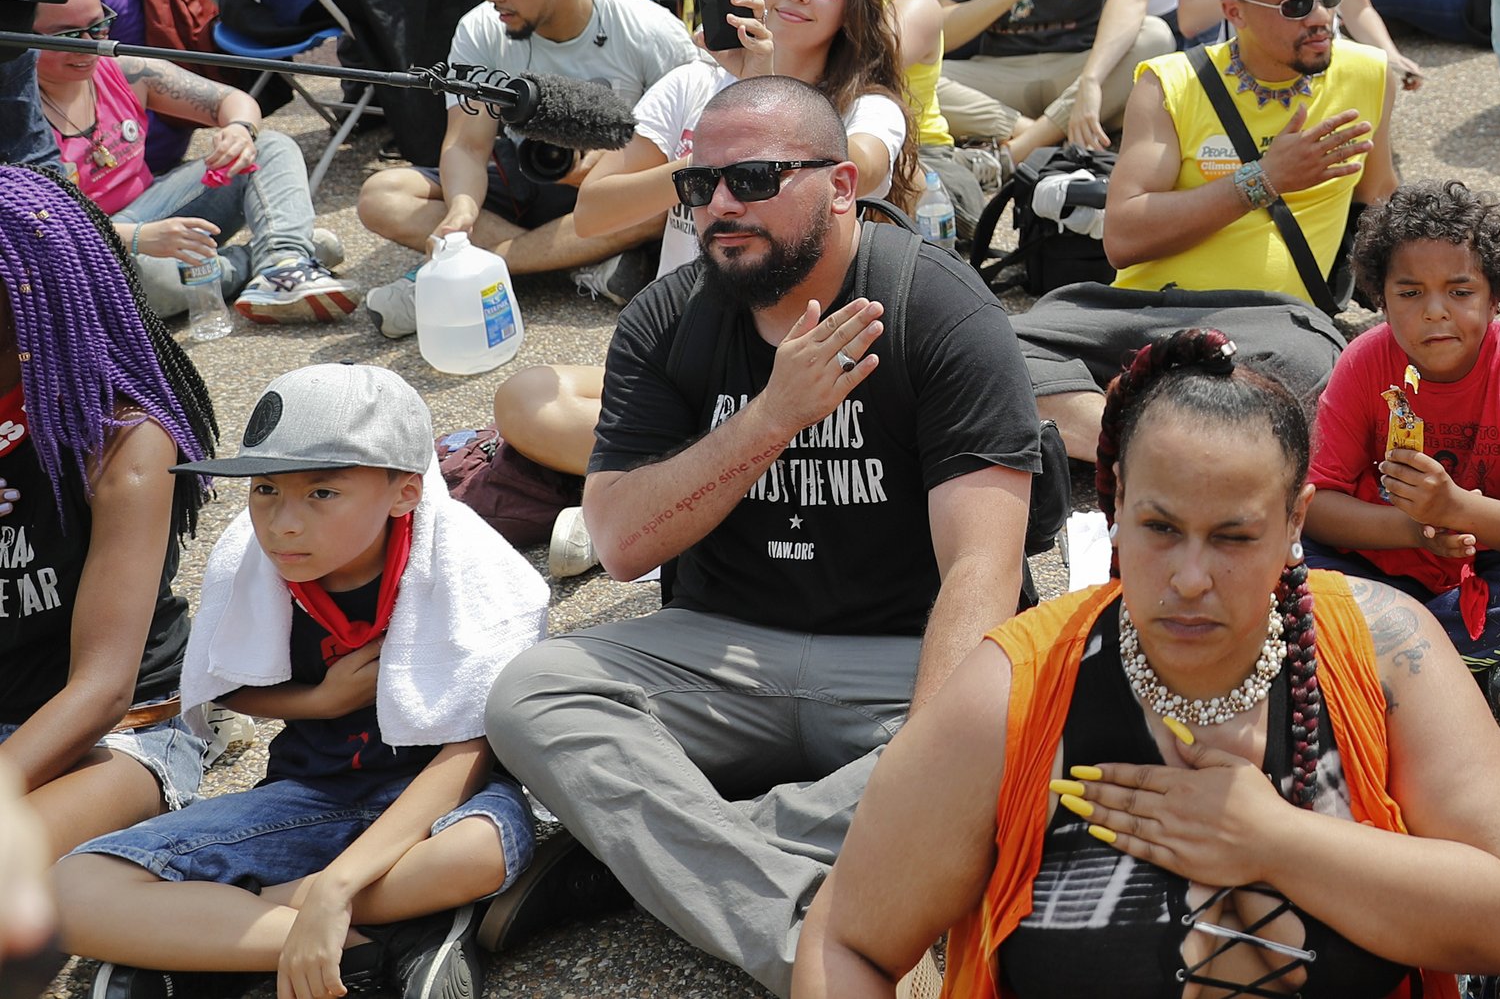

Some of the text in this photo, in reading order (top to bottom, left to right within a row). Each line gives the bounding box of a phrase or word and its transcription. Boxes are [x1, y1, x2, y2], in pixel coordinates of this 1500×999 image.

[790, 458, 828, 507] THE
[826, 457, 888, 506] WAR
[618, 531, 642, 552] dum
[642, 510, 674, 535] spiro
[675, 482, 717, 513] spero
[718, 463, 750, 485] sine
[767, 540, 815, 560] IVAW.ORG
